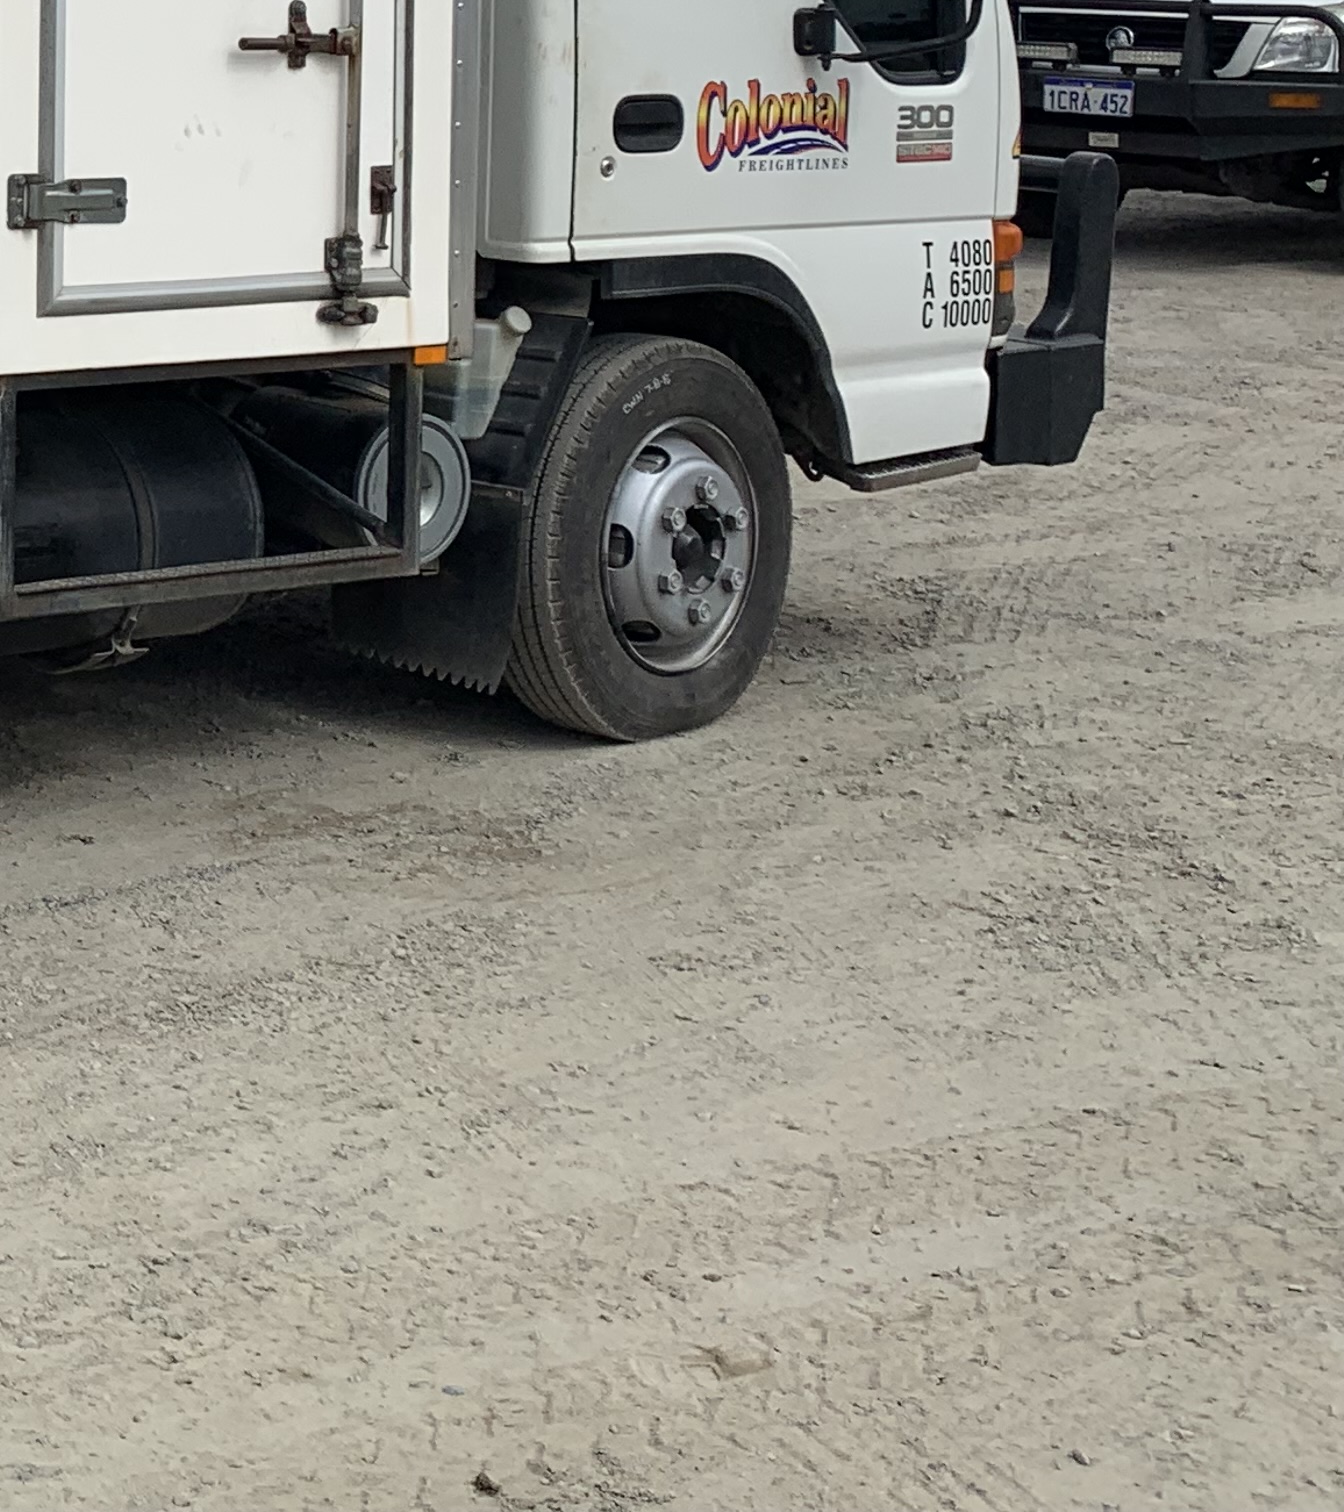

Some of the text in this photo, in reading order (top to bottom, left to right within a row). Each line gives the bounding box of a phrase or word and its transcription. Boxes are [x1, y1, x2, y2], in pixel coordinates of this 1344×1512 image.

[697, 77, 850, 172] Colonial
[897, 104, 954, 129] 300
[738, 157, 849, 173] FREIGHTLINES
[922, 239, 992, 269] T 4080
[922, 268, 992, 299] A 6500
[922, 297, 991, 328] C 10000
